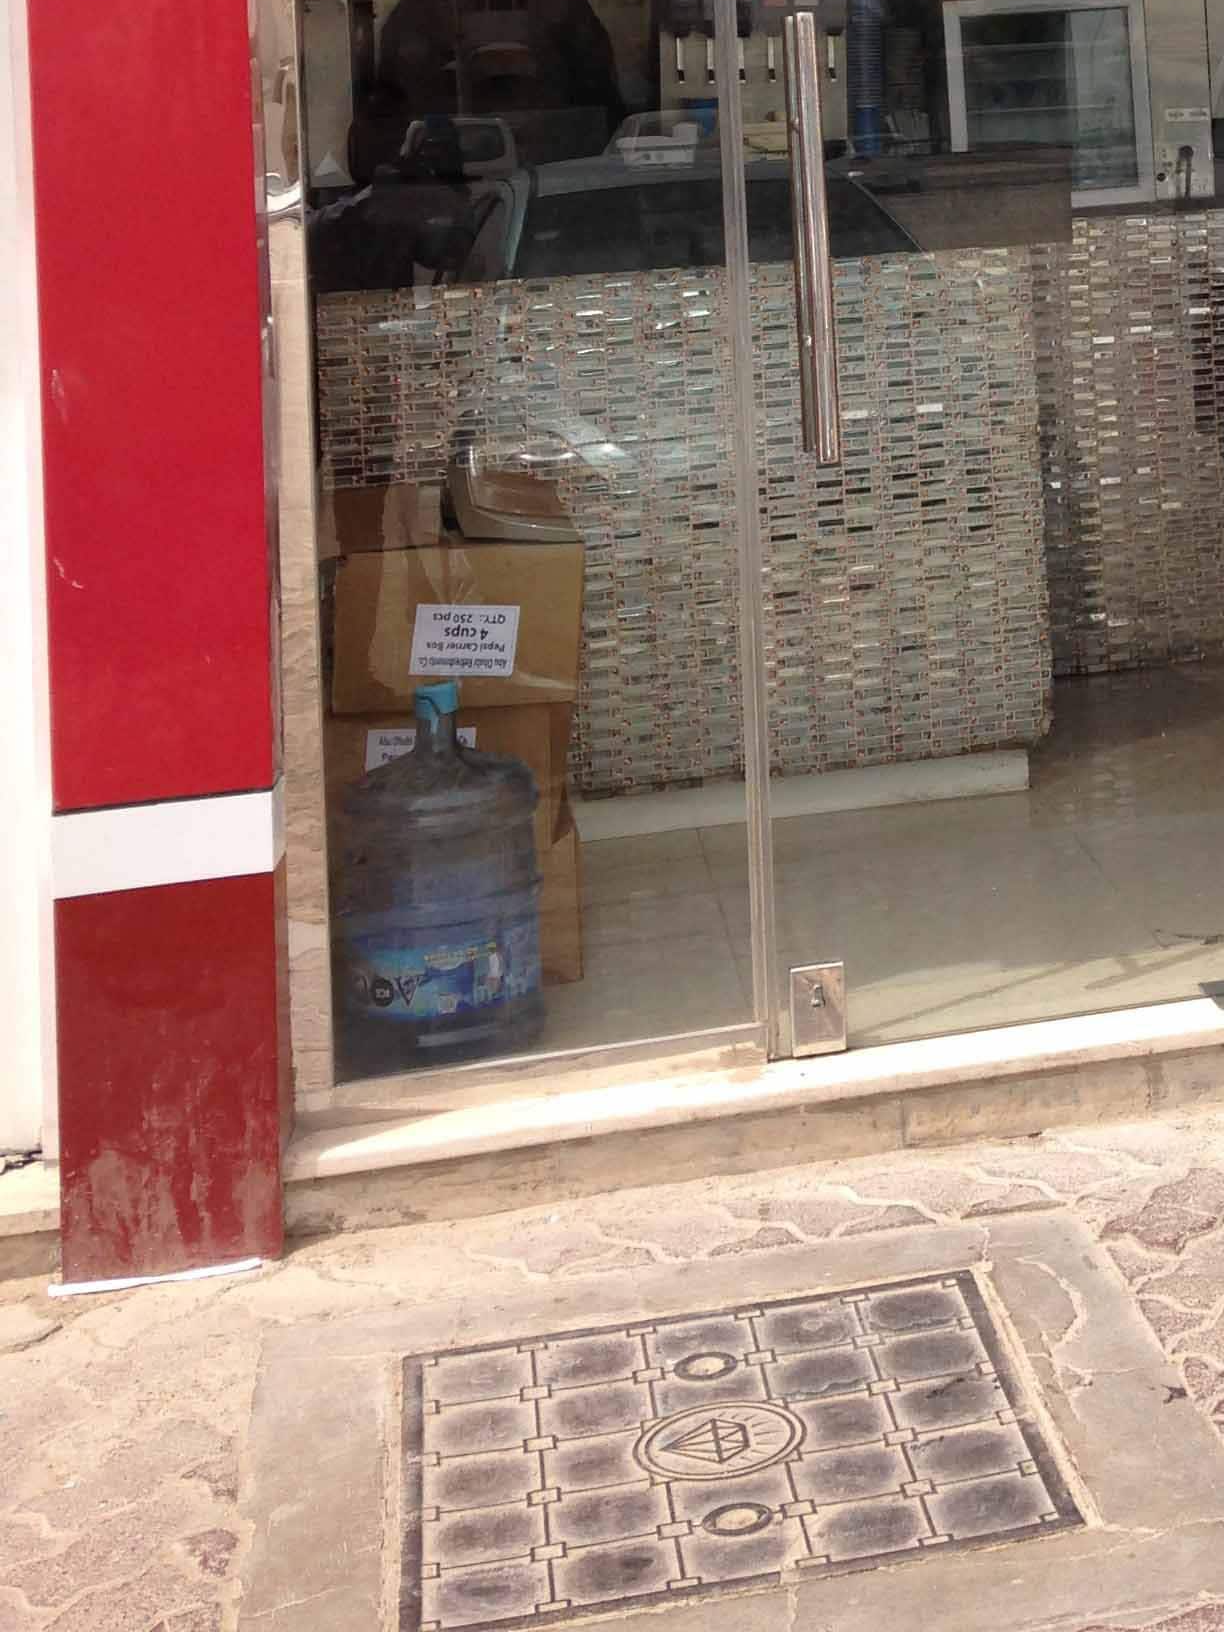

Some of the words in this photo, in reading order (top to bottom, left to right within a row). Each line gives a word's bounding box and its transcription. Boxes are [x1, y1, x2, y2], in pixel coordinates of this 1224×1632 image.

[432, 612, 452, 622] pcs
[453, 613, 473, 624] 250
[444, 624, 477, 638] cups
[480, 628, 489, 641] 4
[480, 641, 505, 652] Pepsi
